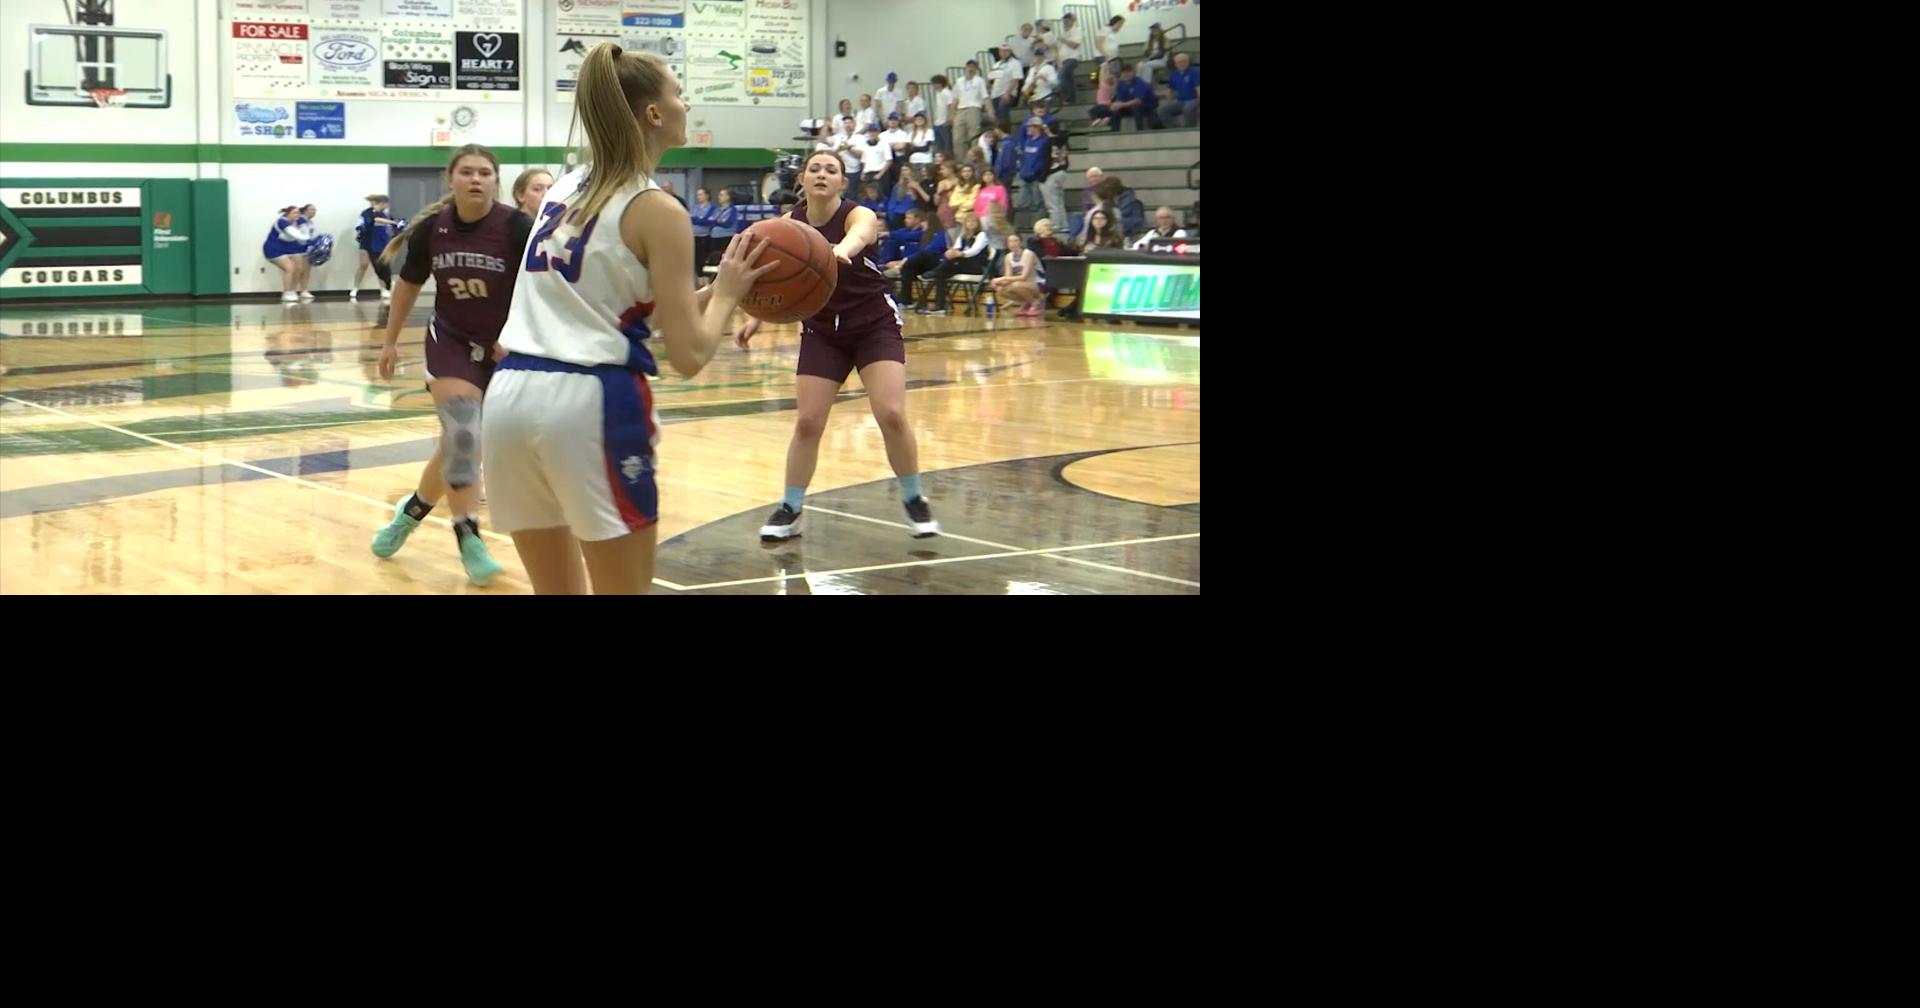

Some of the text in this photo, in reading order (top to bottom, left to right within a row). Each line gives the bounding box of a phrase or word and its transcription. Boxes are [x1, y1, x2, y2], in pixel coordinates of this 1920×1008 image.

[240, 25, 267, 38] FOR
[269, 26, 301, 39] SALE
[324, 41, 366, 61] Ford
[461, 59, 514, 70] HEART 7
[405, 71, 437, 87] Sign
[20, 191, 123, 205] COLUMBUS
[432, 251, 505, 273] PANTHERS
[21, 269, 123, 283] COUGARS
[447, 278, 488, 299] 20
